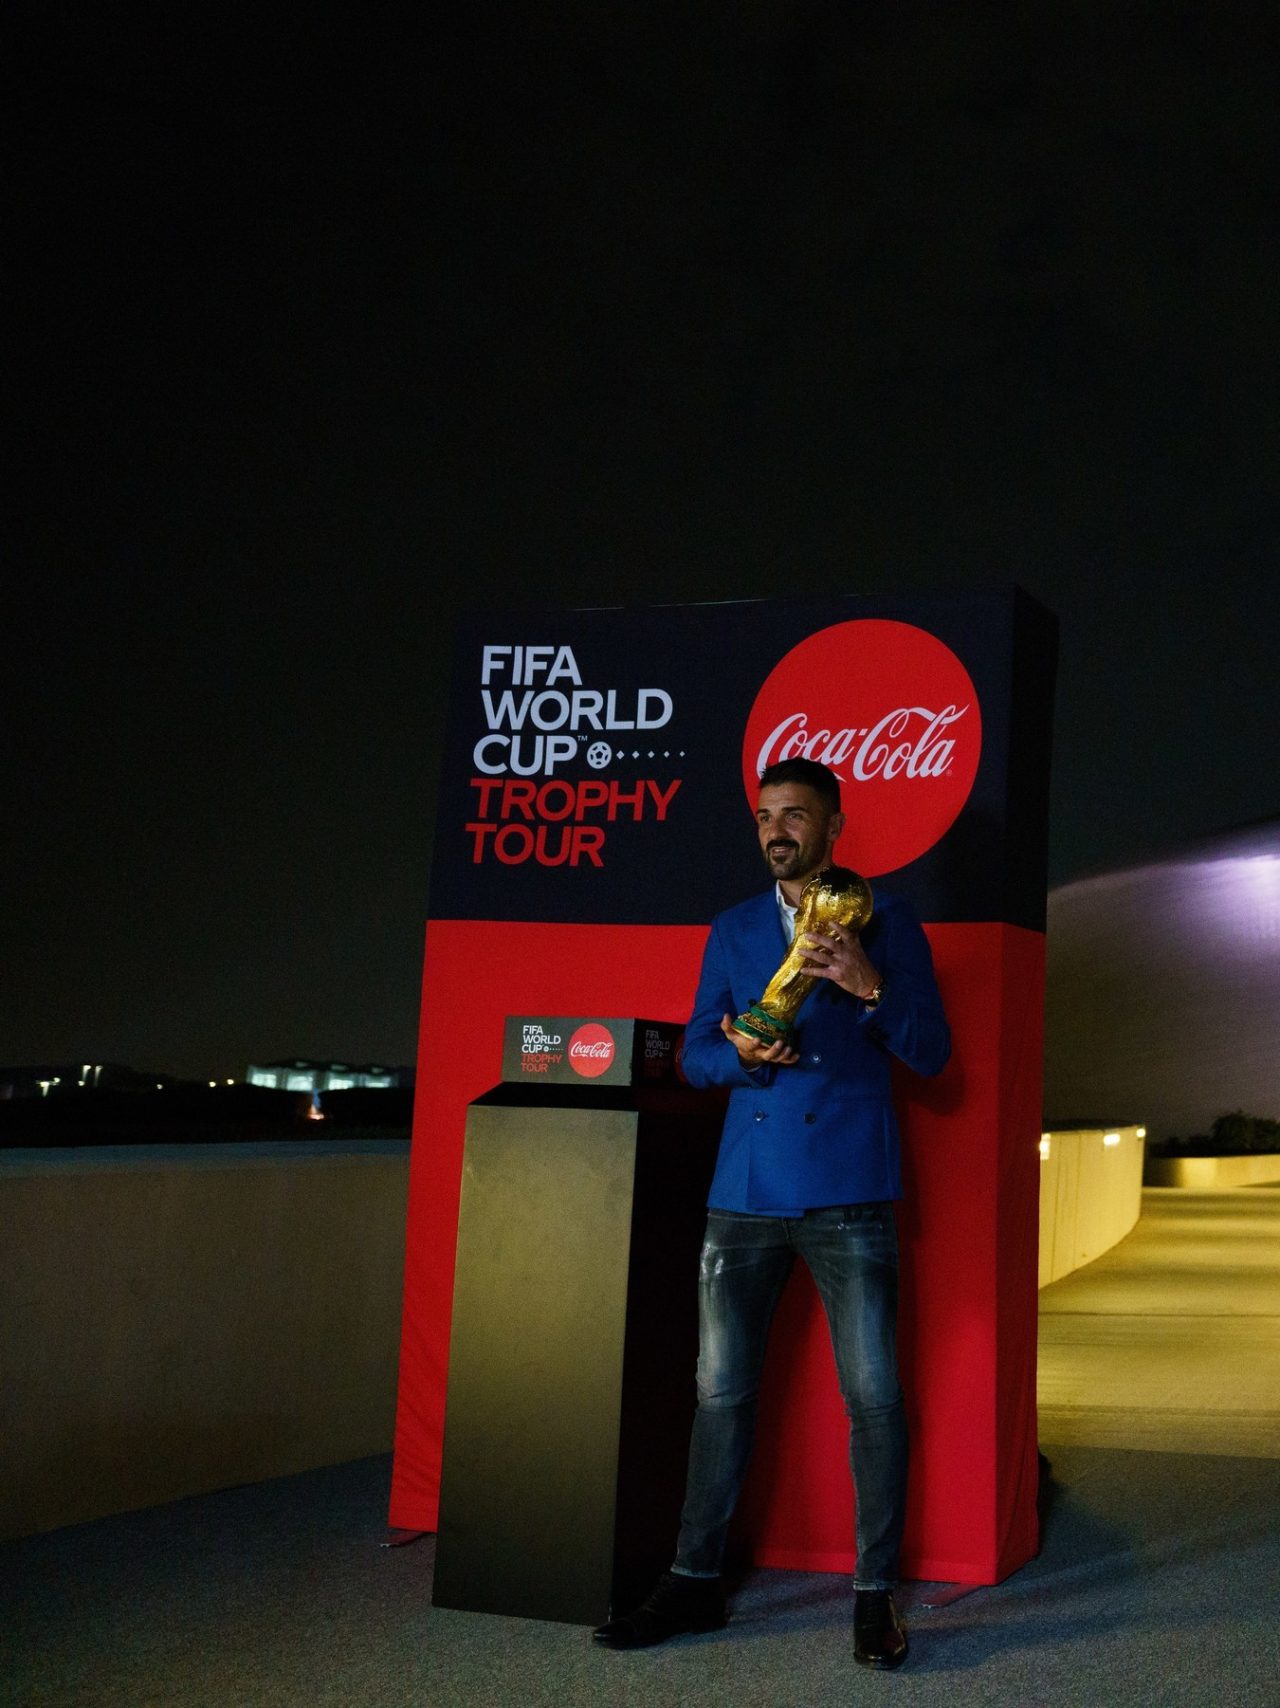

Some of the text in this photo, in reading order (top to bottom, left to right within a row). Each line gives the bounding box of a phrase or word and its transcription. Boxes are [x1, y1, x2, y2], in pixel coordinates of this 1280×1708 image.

[481, 646, 583, 686] FIFA
[481, 688, 673, 731] WORLD
[756, 703, 970, 783] Coca-Cola
[470, 778, 683, 821] TROPHY
[465, 823, 606, 868] TOUR
[522, 1025, 544, 1035] FIFA
[522, 1035, 561, 1045] WORLD
[521, 1044, 542, 1054] CUP
[570, 1041, 613, 1058] Coca-Cola
[521, 1053, 562, 1063] TROPHY
[521, 1063, 549, 1073] TOUR
